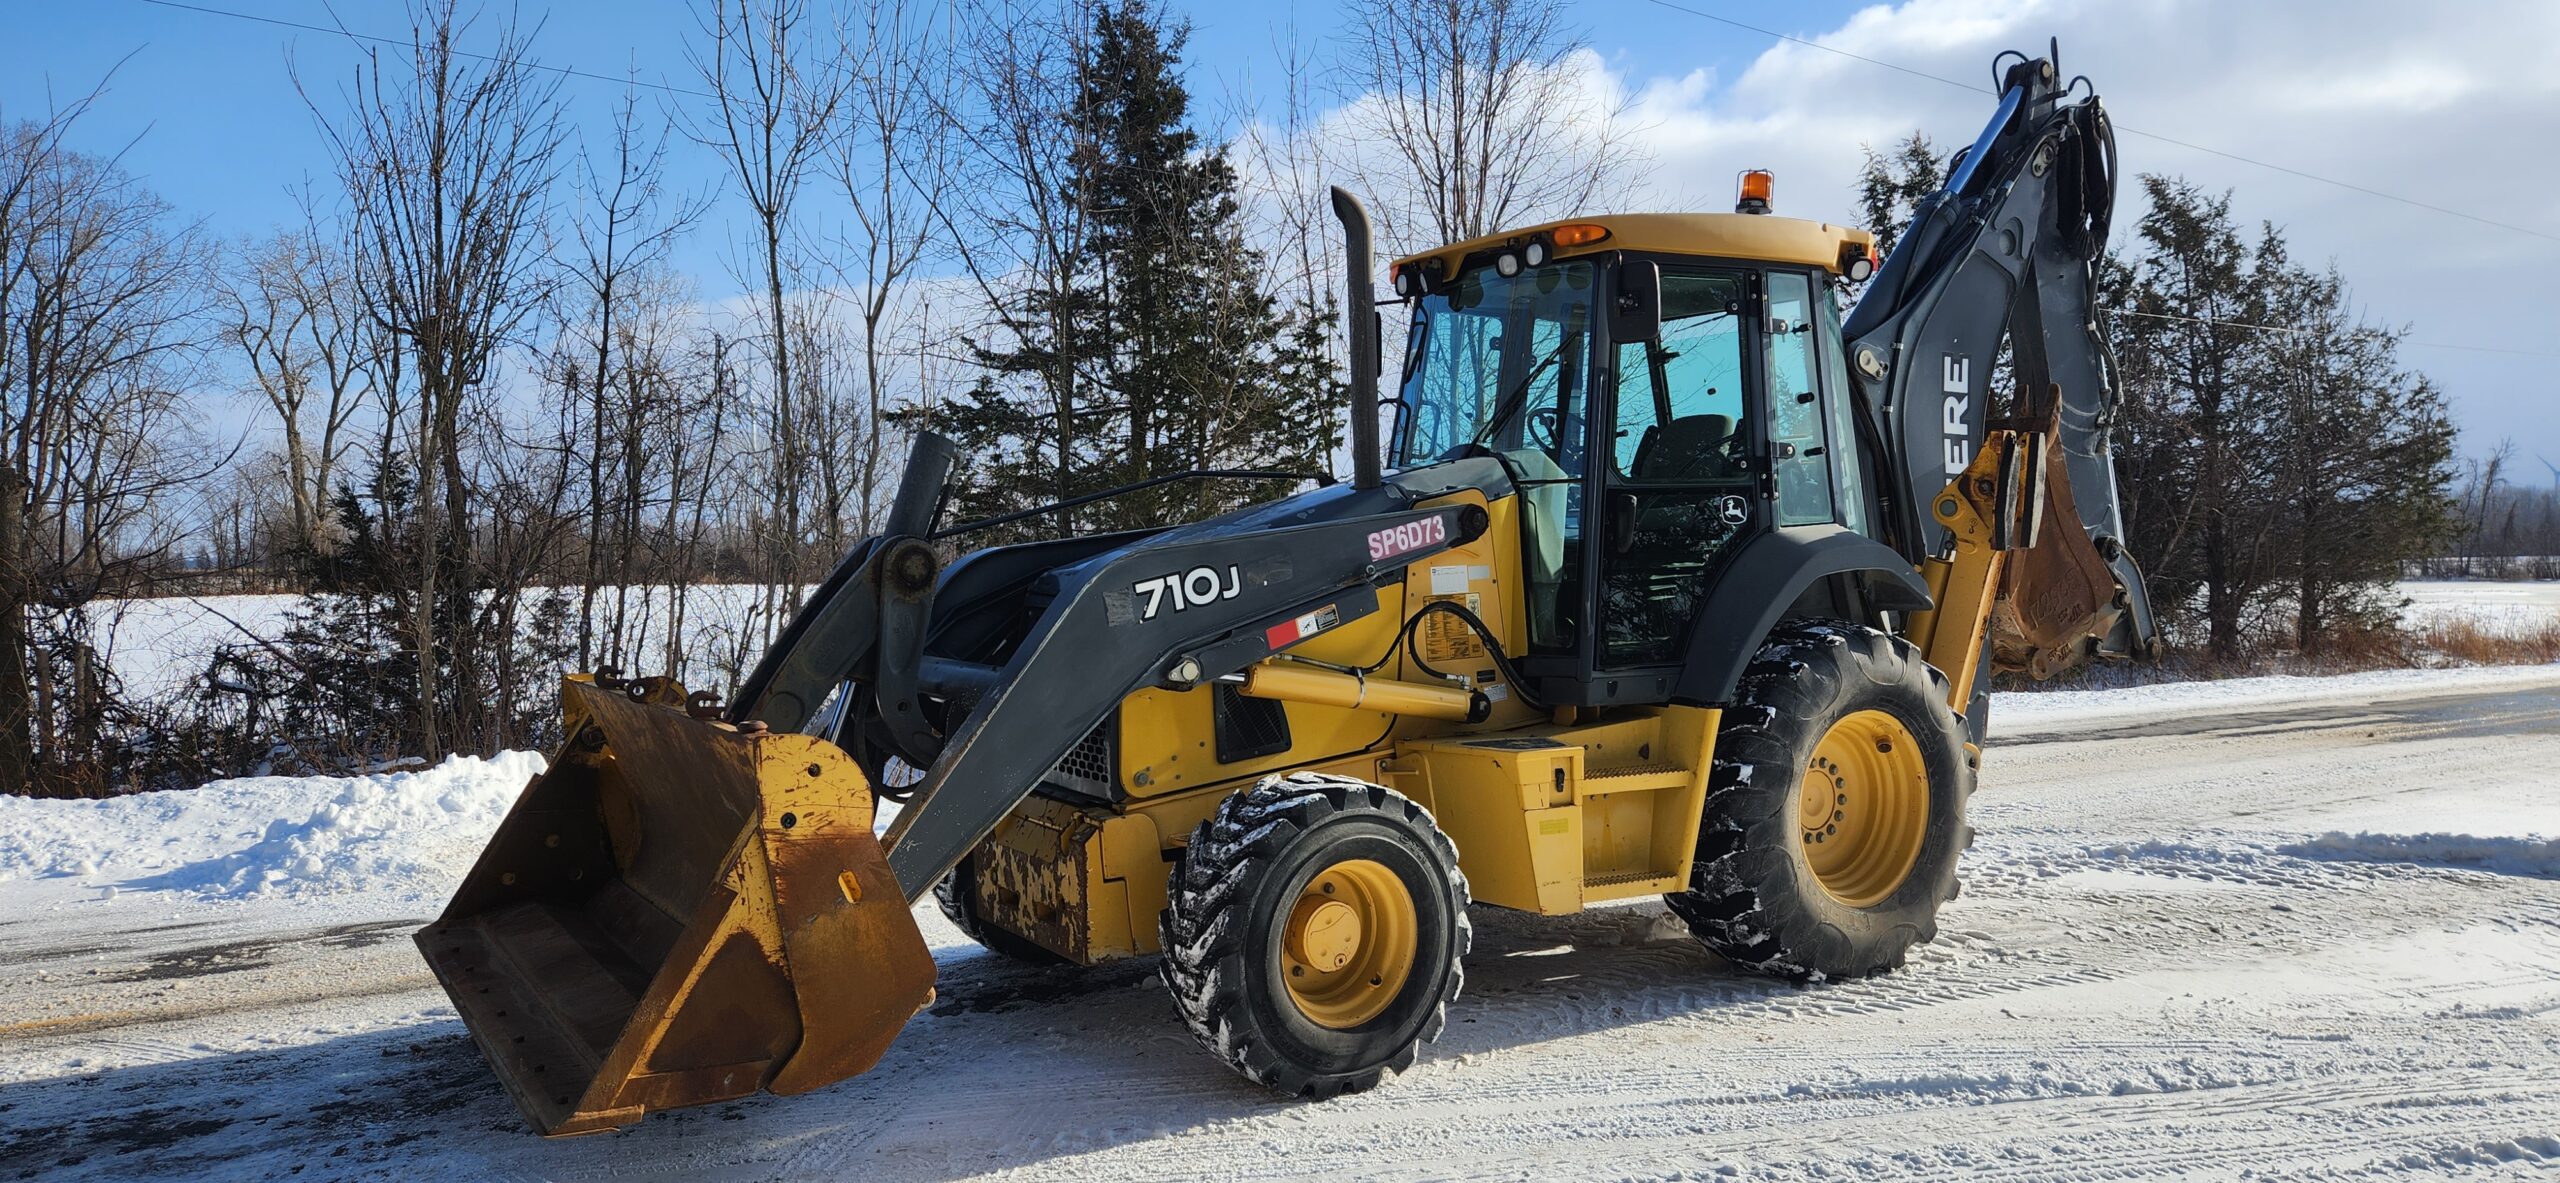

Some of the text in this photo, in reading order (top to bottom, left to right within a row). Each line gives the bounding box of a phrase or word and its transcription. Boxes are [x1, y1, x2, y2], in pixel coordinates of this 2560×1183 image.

[1943, 356, 1969, 486] ERE
[1368, 514, 1446, 559] SP6D73
[1133, 565, 1241, 620] 710J
